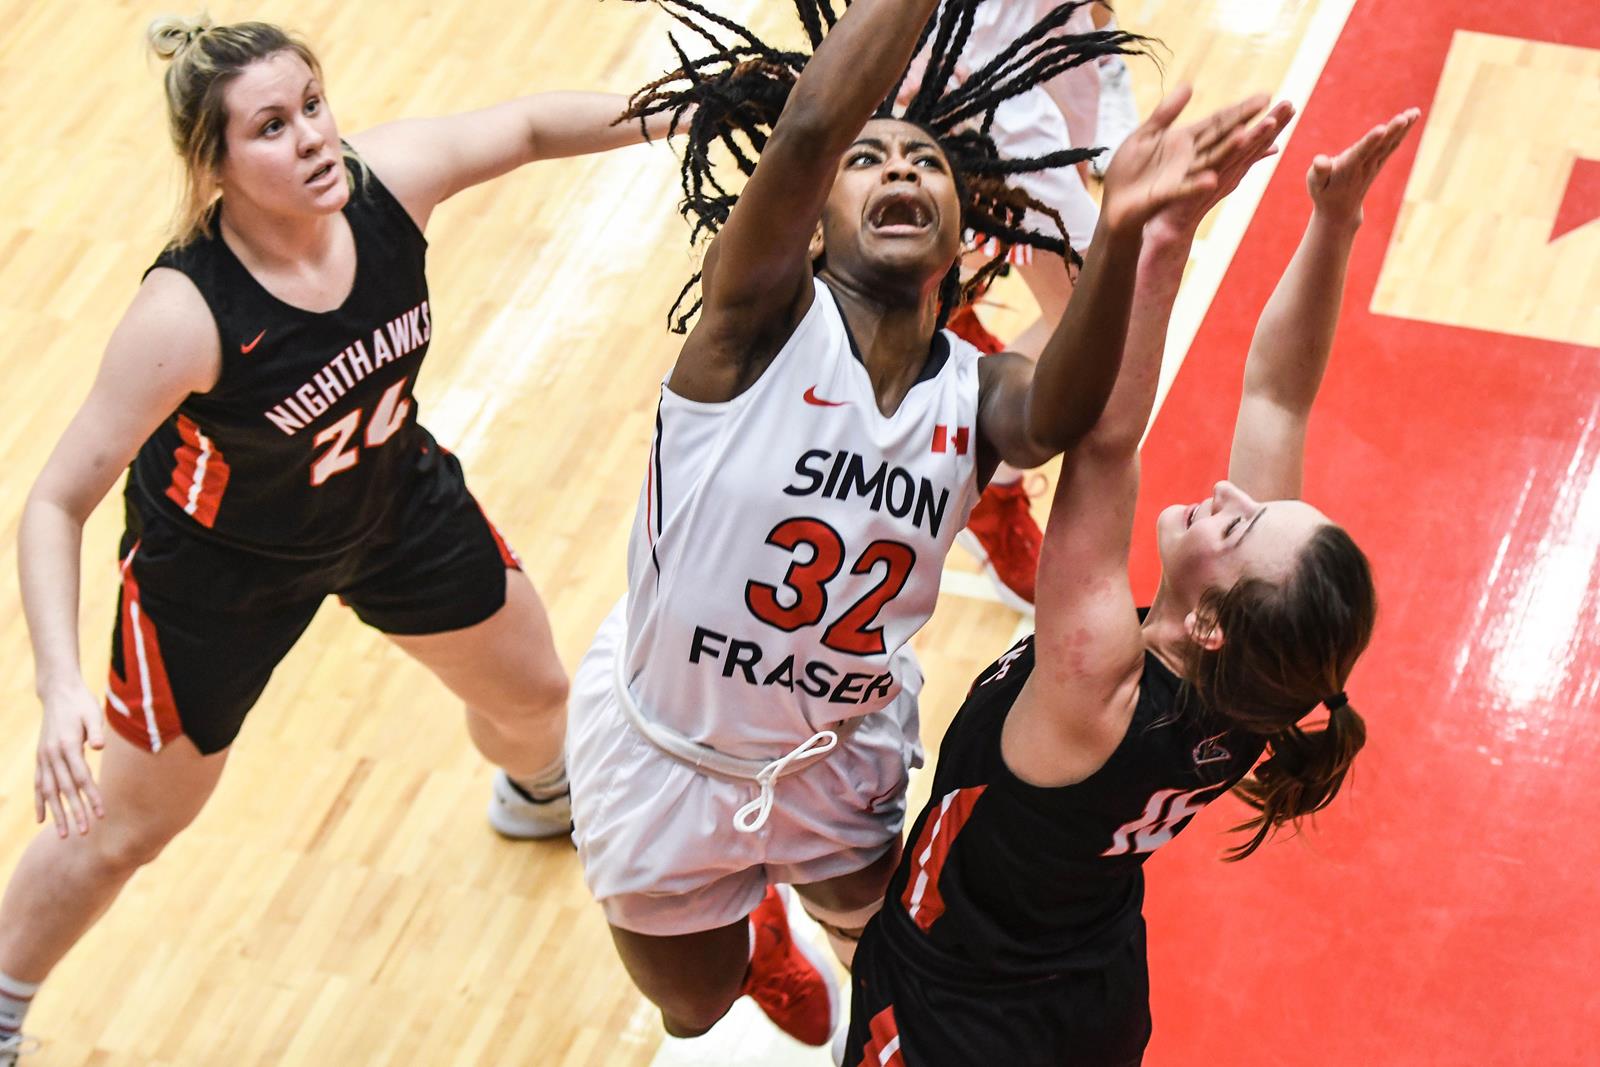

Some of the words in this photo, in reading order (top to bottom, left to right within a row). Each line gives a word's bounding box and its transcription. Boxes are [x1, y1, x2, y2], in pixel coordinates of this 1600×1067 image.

[264, 301, 430, 436] NIGHTHAWKS
[782, 449, 949, 539] SIMON
[744, 516, 916, 657] 32
[689, 625, 893, 704] FRASER
